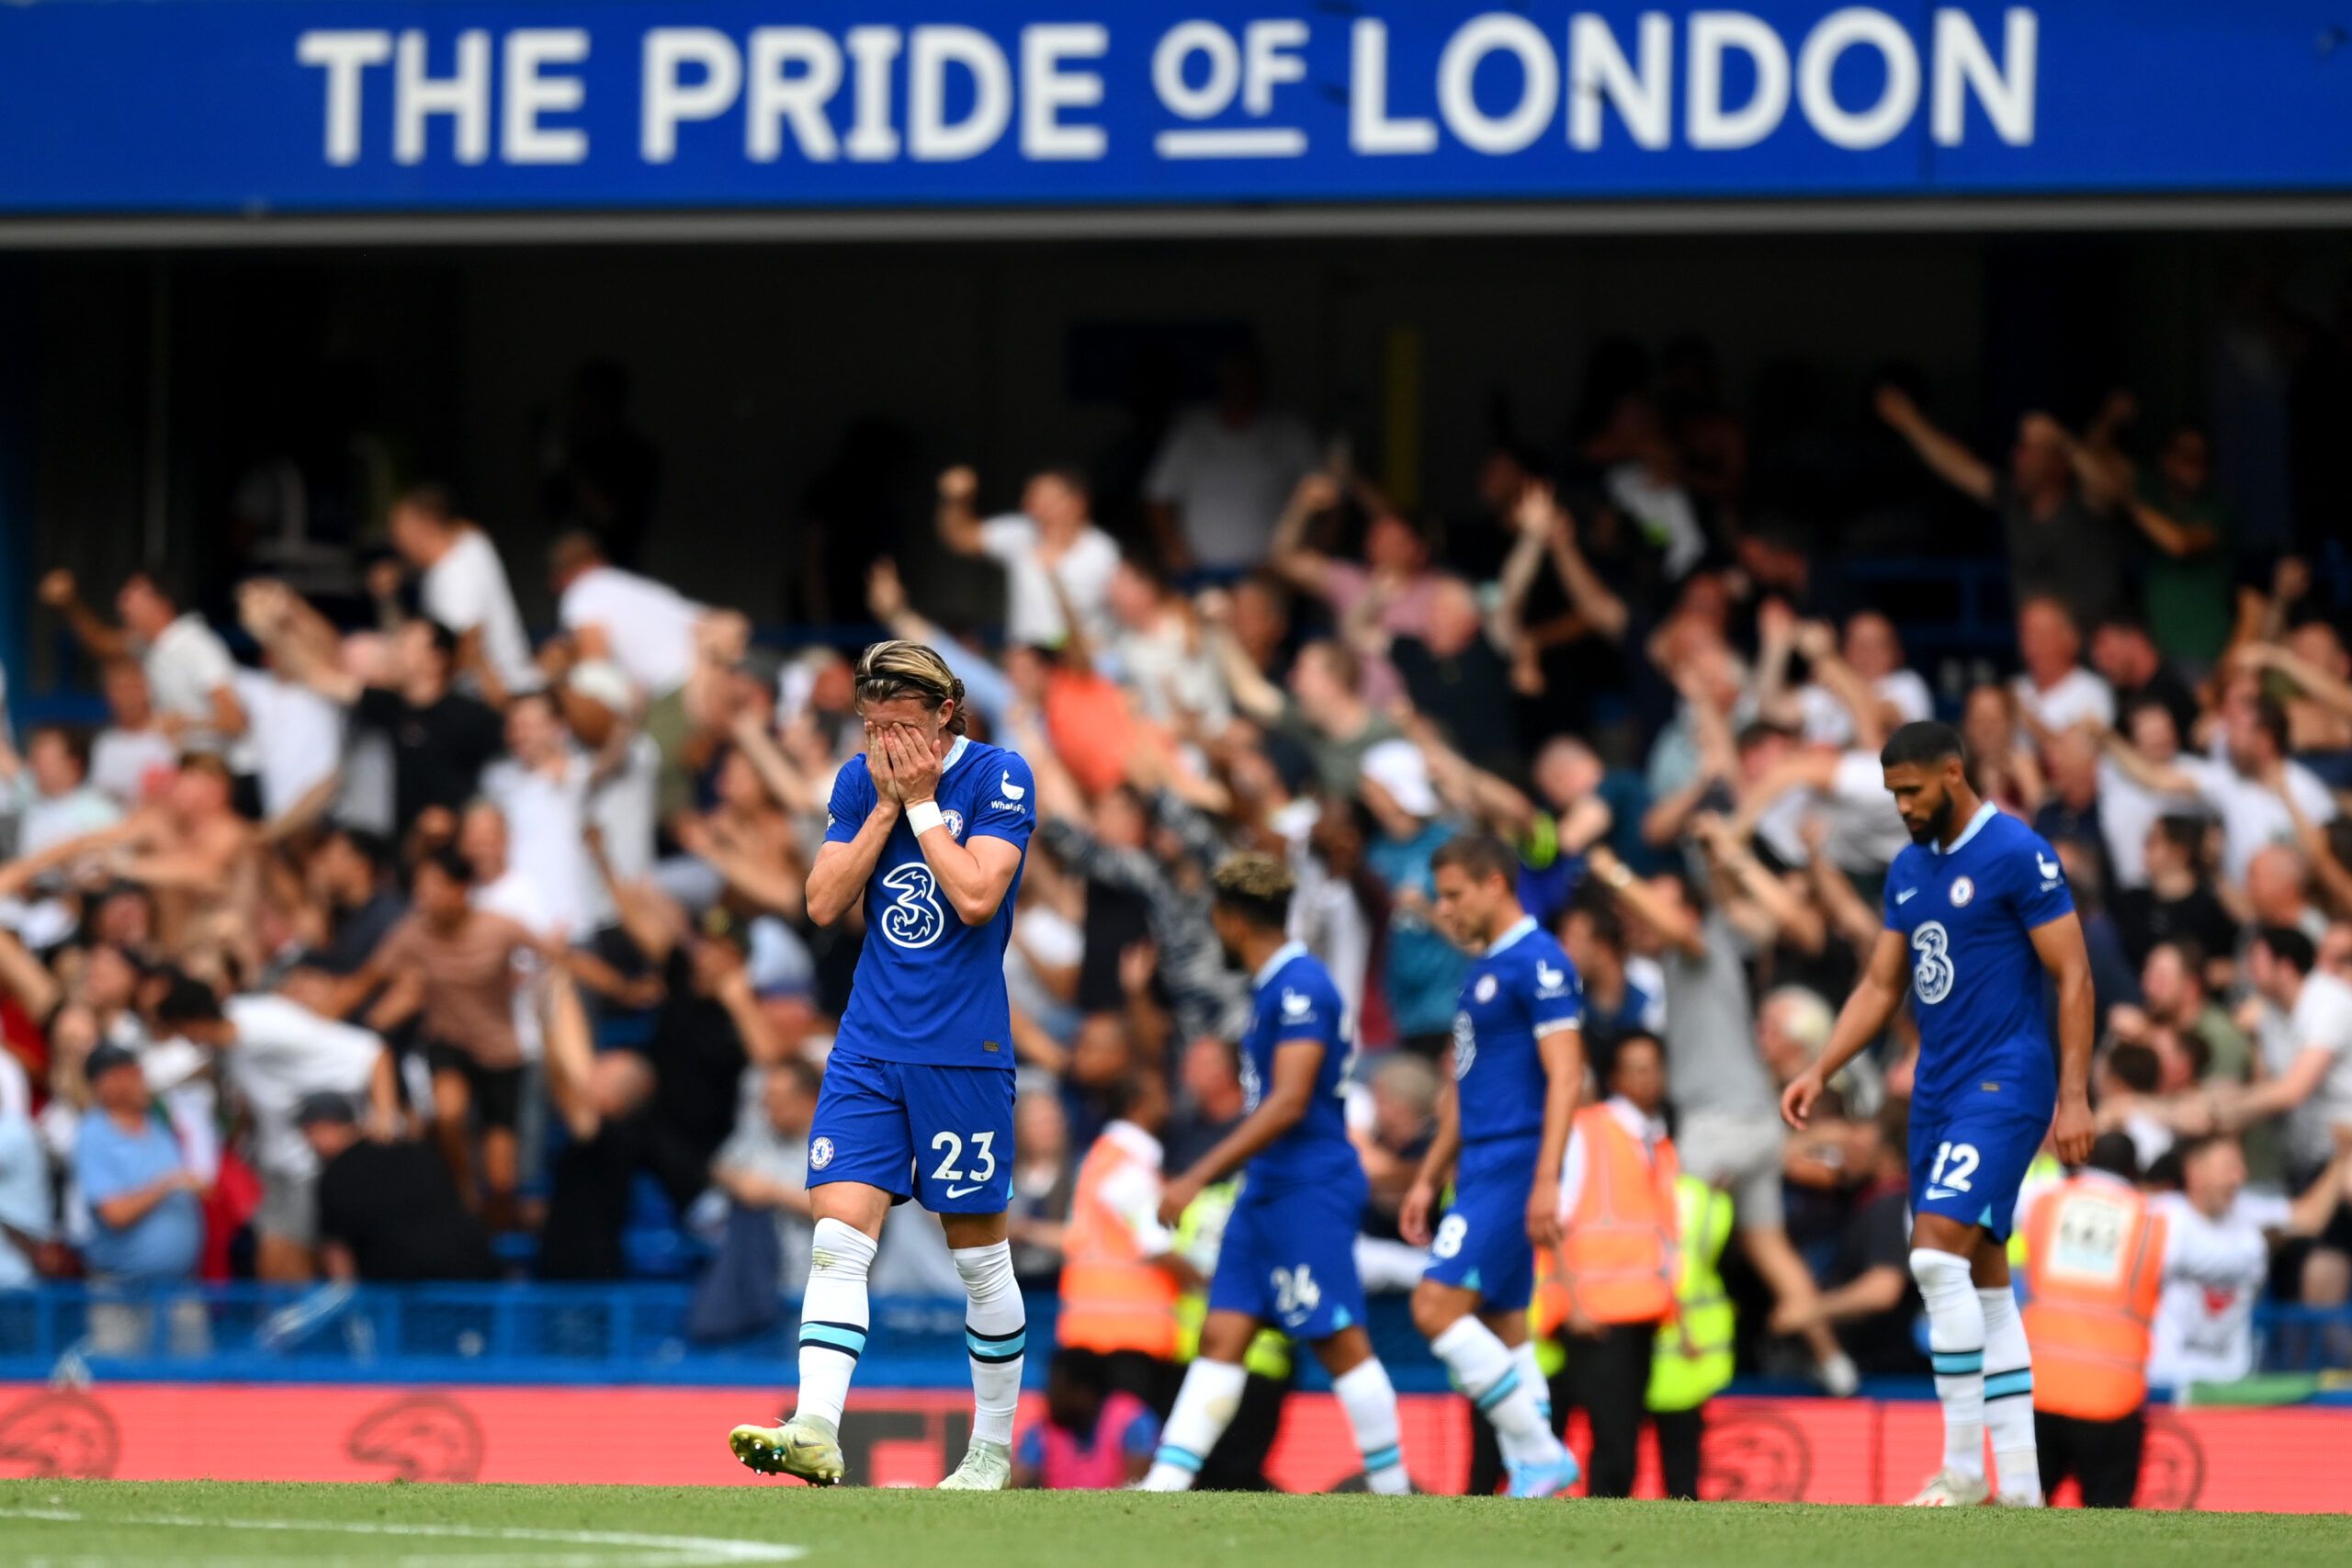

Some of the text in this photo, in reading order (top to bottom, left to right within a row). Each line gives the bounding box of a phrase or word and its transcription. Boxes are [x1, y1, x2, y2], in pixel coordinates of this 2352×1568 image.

[298, 8, 2037, 164] THE PRIDE OF LONDON
[932, 1131, 995, 1182] 23
[1930, 1141, 1980, 1192] 12
[1270, 1263, 1320, 1313] 24
